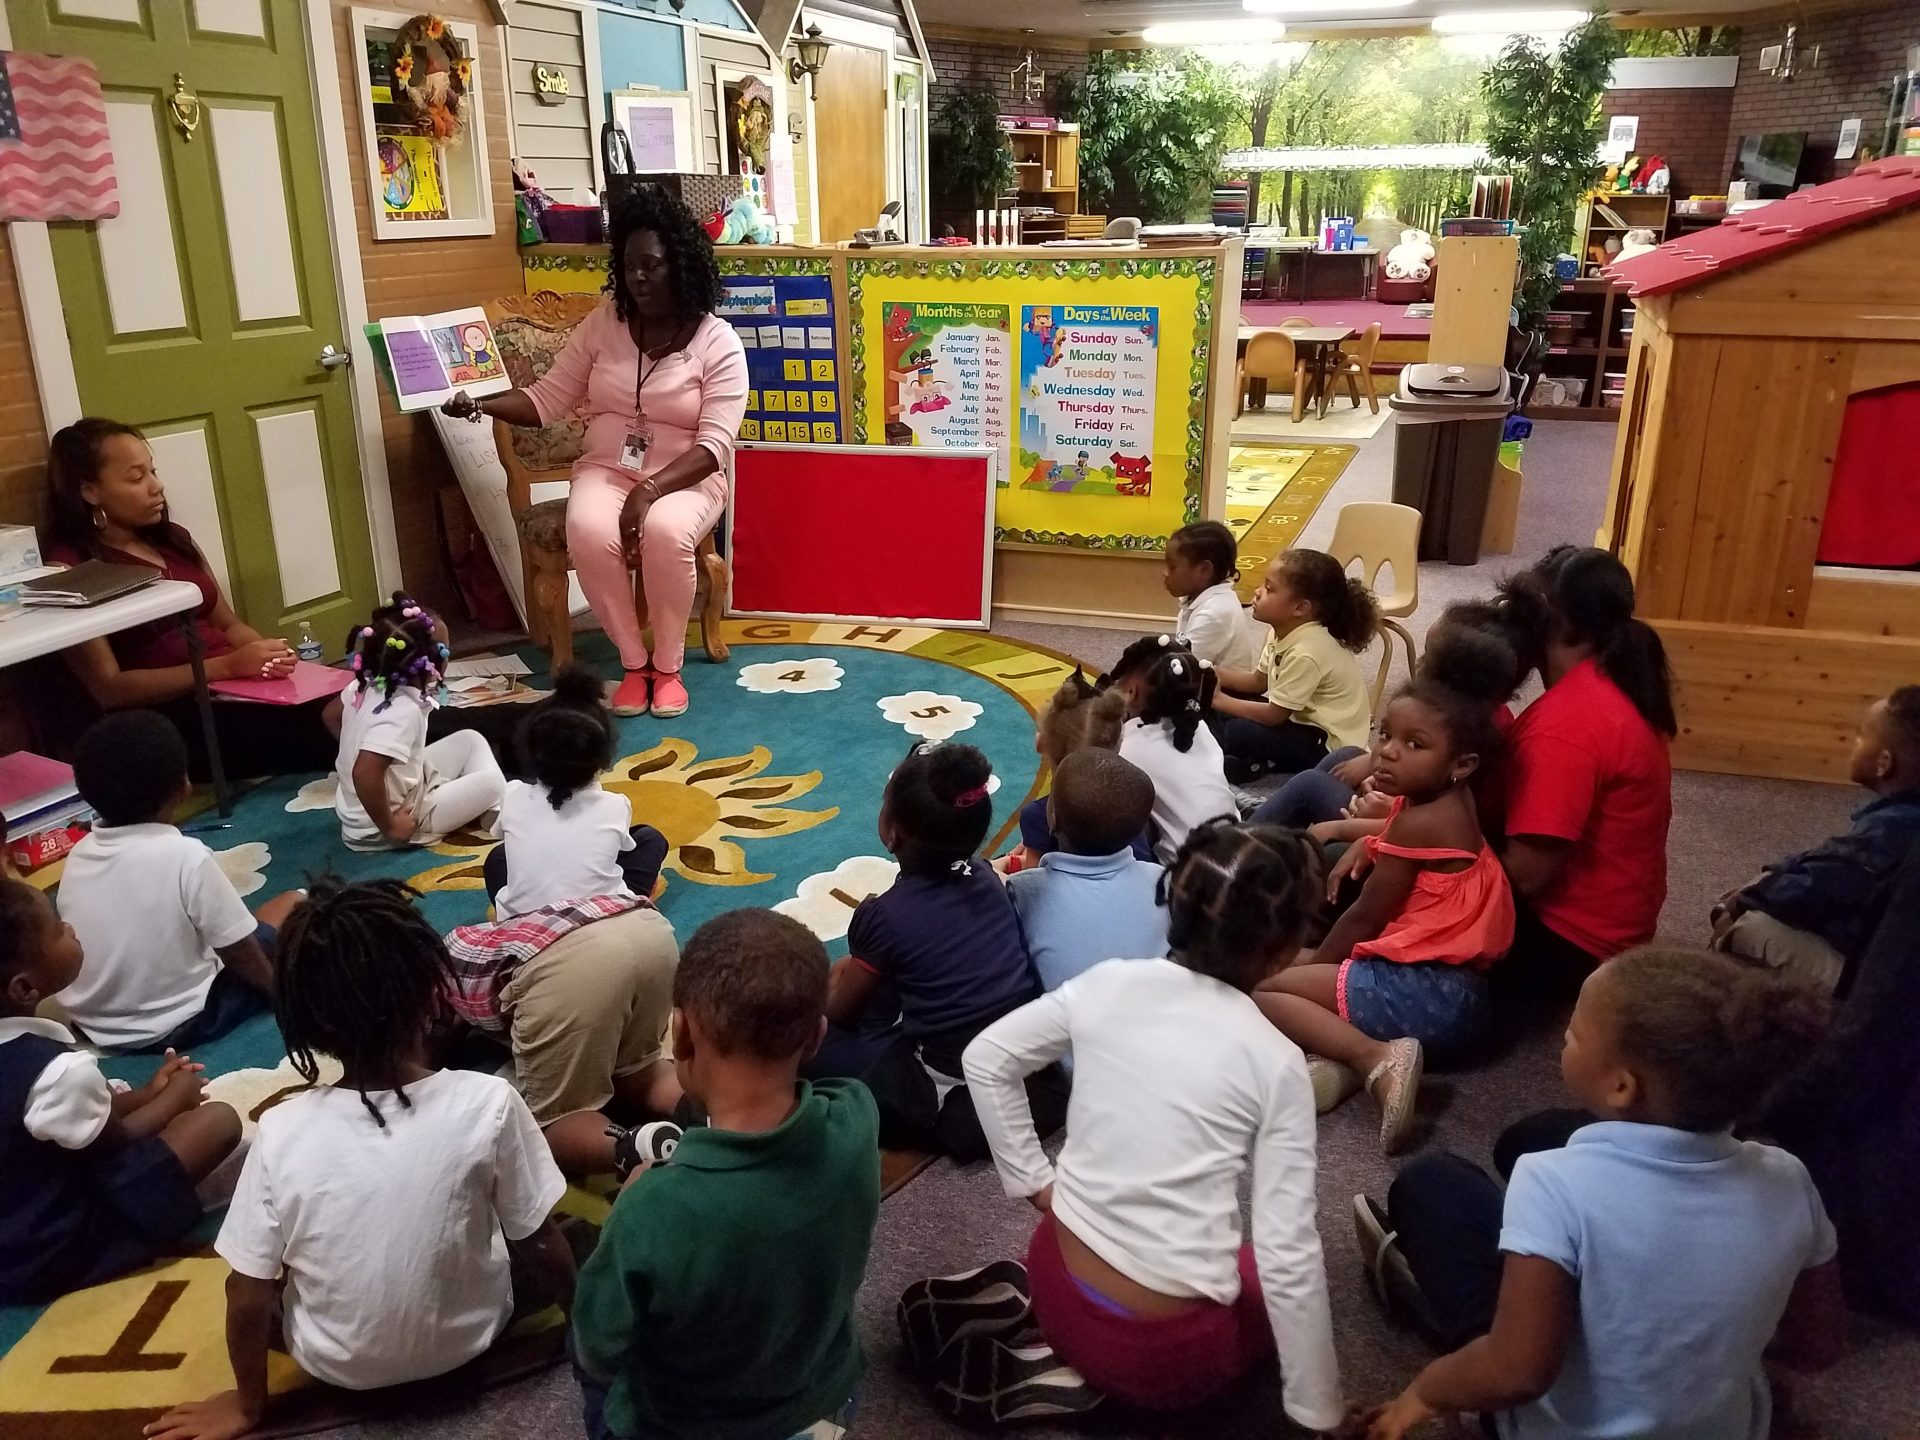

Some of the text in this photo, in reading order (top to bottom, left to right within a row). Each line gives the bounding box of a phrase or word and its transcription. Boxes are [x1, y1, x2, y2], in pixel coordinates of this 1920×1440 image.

[537, 67, 569, 94] Smile
[721, 293, 773, 309] eptember
[916, 304, 963, 318] Months
[973, 305, 1001, 318] Year
[1064, 307, 1100, 323] Days
[1110, 307, 1150, 321] Week
[946, 333, 1001, 343] January Jan.
[1071, 331, 1143, 345] Sunday Sun.
[940, 345, 980, 355] February
[1069, 349, 1143, 363] Monday Mon.
[953, 357, 980, 365] March
[792, 364, 797, 377] 1
[819, 364, 827, 377] 2
[960, 369, 1002, 379] April Apr.
[1064, 367, 1146, 380] Tuesday Tues.
[962, 381, 1000, 391] May May
[1043, 383, 1144, 398] Wednesday Wed.
[770, 395, 777, 407] 7
[794, 395, 802, 407] 8
[820, 396, 828, 407] 9
[960, 393, 980, 401] June
[963, 405, 999, 415] July July
[1058, 400, 1148, 415] Thursday Thurs.
[949, 416, 1003, 426] August Aug.
[1075, 418, 1114, 432] Friday
[744, 424, 756, 436] 13
[768, 425, 782, 438] 14
[793, 426, 806, 438] 15
[818, 426, 831, 438] 16
[931, 426, 980, 436] September
[945, 439, 980, 447] October
[1055, 434, 1113, 448] Saturday
[742, 624, 1065, 680] G H I J
[777, 670, 806, 682] 4
[910, 705, 951, 719] 5
[41, 838, 57, 853] 28
[45, 1279, 191, 1375] T
